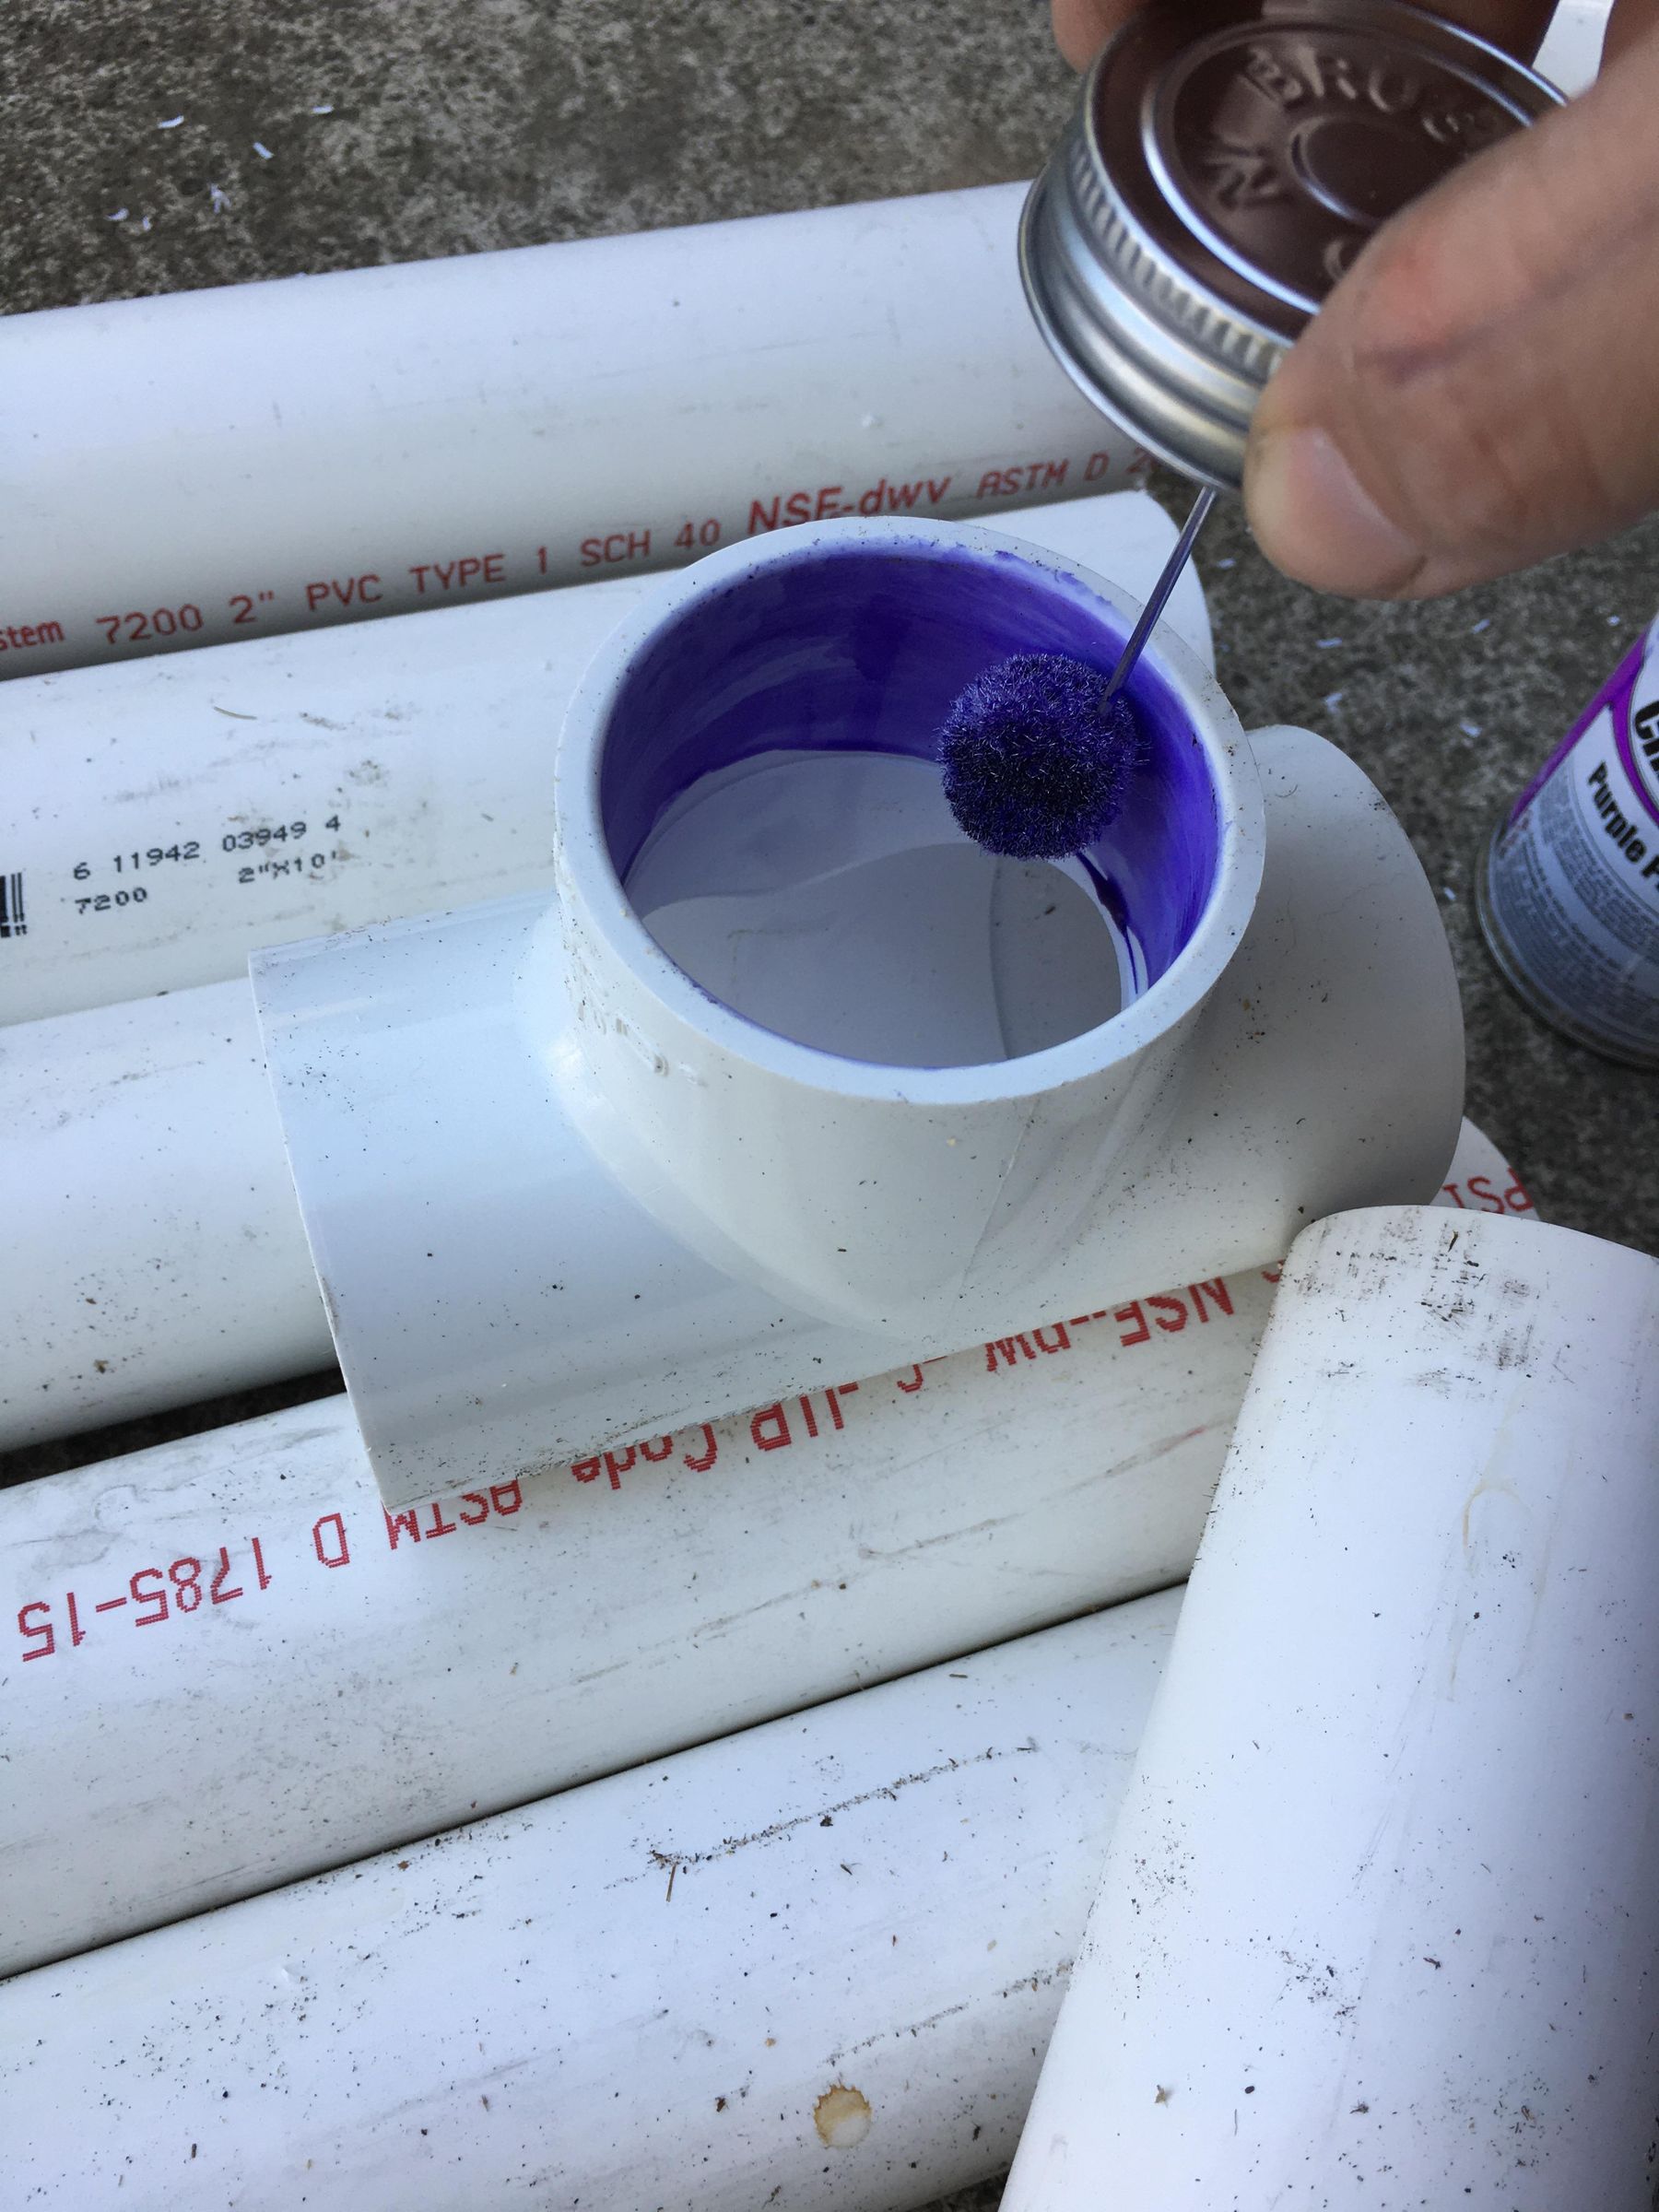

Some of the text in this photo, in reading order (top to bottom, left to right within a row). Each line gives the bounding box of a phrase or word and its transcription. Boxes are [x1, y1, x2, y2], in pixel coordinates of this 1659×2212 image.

[97, 605, 203, 644] 7200
[229, 592, 275, 624] 2"
[306, 574, 383, 612] PVC
[410, 554, 505, 594] TYPE
[580, 529, 651, 568] SCH
[676, 519, 720, 551] 40
[977, 461, 1067, 500] ASTM
[1084, 452, 1110, 480] D
[73, 815, 342, 880] 6 11942 03949 4
[1588, 760, 1647, 864] Purple
[75, 887, 148, 914] 7200
[312, 1512, 350, 1569] D
[17, 1537, 273, 1662] 1785-15
